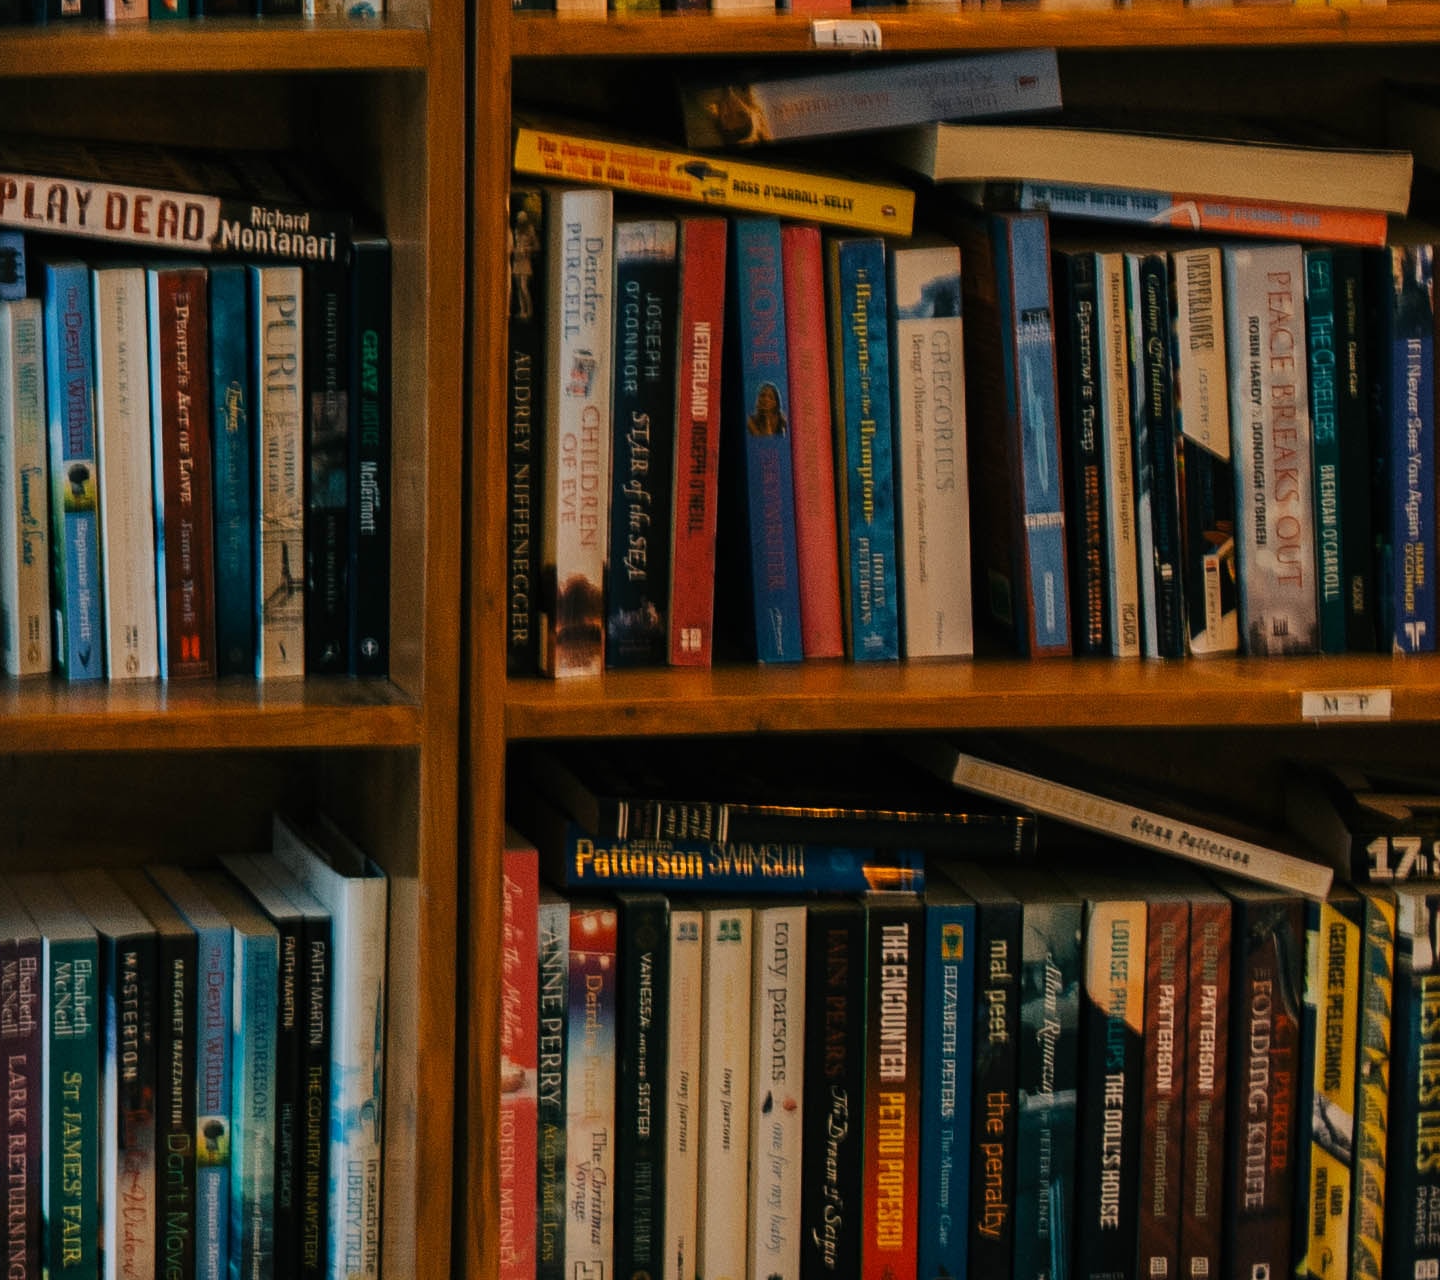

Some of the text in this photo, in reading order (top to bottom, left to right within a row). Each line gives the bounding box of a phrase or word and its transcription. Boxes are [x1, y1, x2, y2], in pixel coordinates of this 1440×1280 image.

[105, 191, 206, 243] DEAD
[220, 219, 337, 261] Montanari
[251, 207, 310, 231] Richard
[979, 1143, 1007, 1236] penalty
